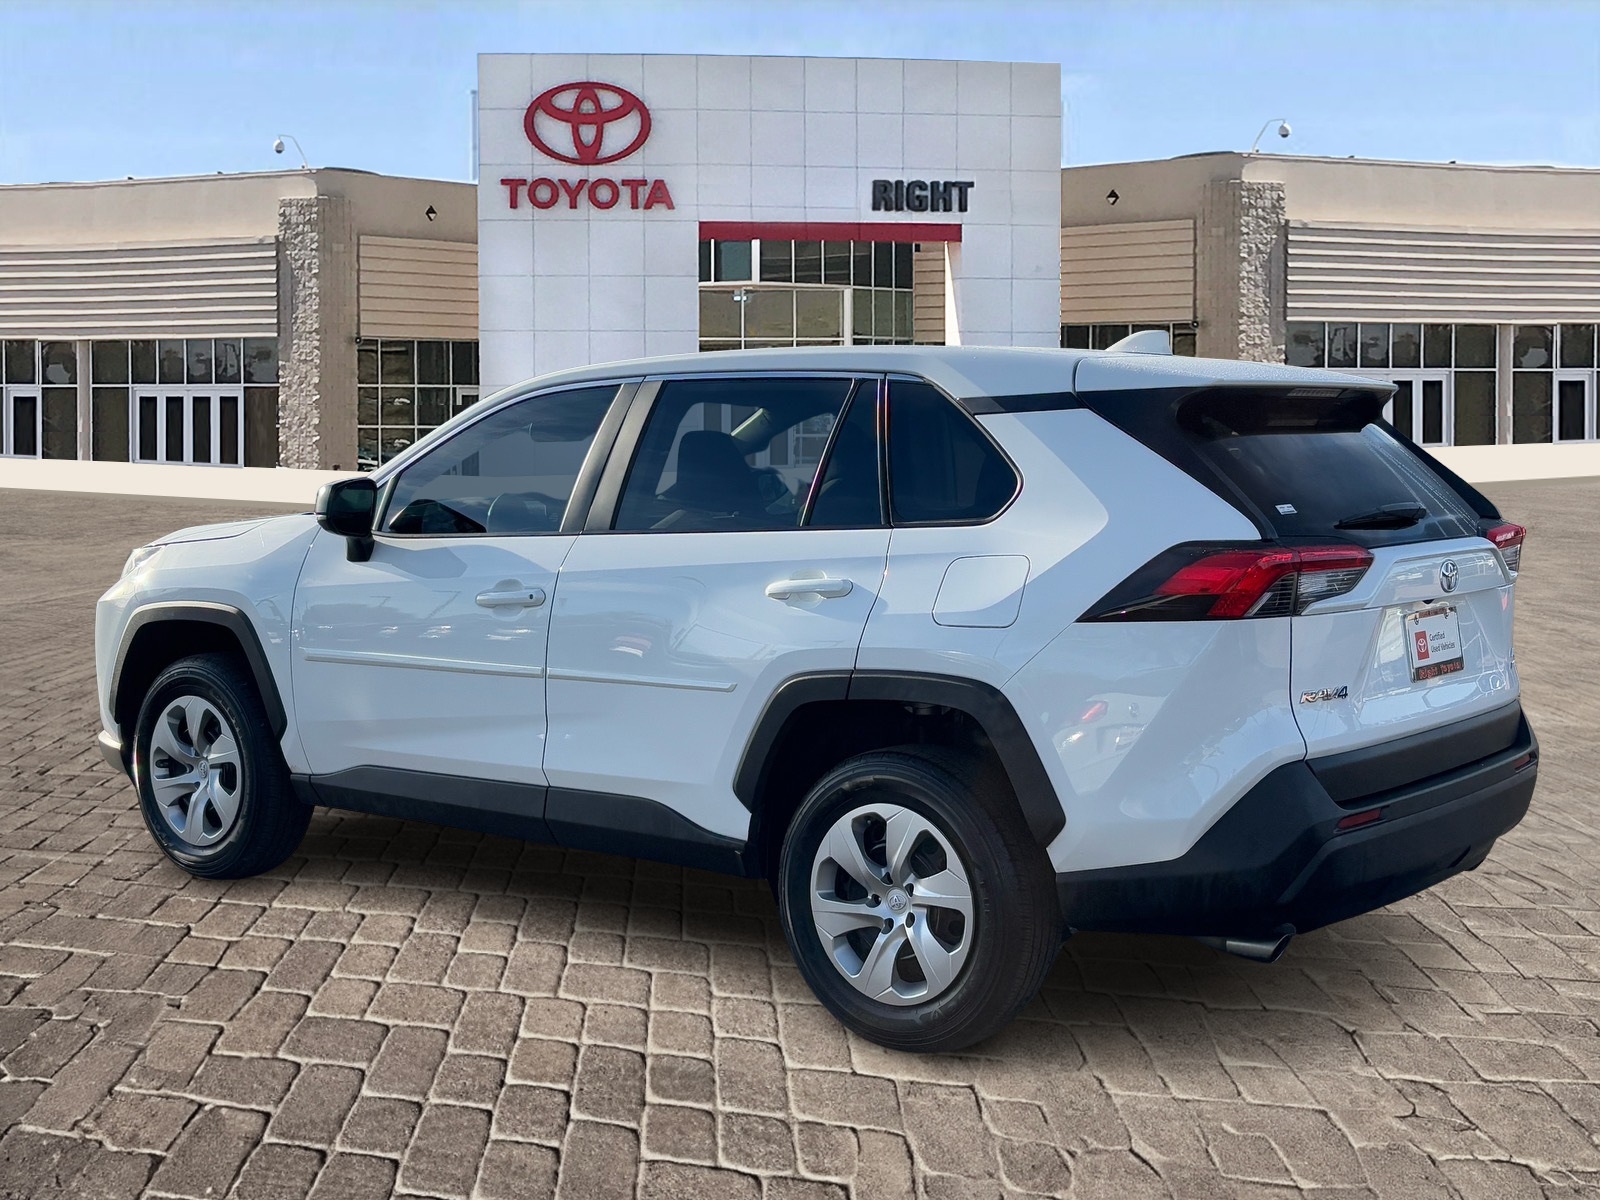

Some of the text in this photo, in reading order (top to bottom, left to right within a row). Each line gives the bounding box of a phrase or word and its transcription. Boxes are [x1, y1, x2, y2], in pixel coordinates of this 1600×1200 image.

[500, 178, 675, 210] TOYOTA
[872, 179, 975, 212] RIGHT
[1429, 631, 1446, 641] Certified
[1431, 641, 1456, 653] Used Vehicles
[1299, 686, 1348, 704] RAV4
